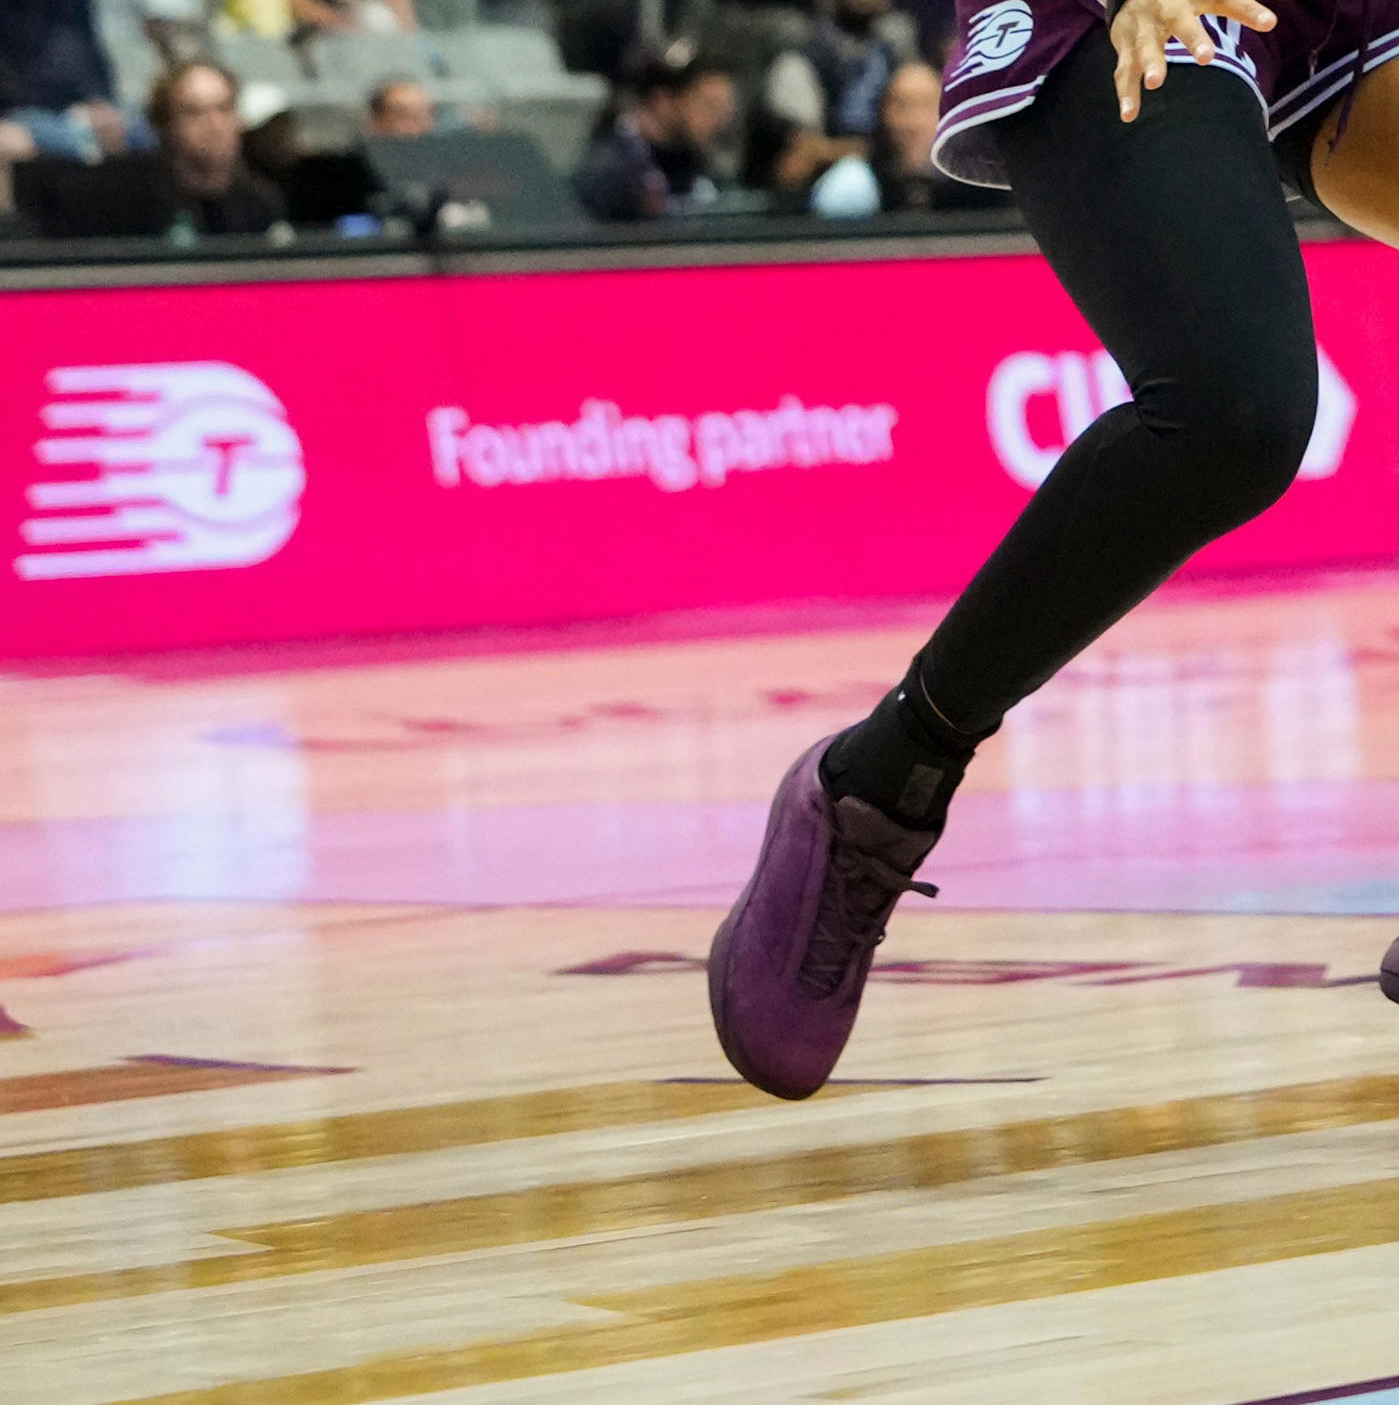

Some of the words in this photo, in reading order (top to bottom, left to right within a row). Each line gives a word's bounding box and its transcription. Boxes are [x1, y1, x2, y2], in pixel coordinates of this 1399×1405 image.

[425, 397, 698, 493] Founding
[696, 394, 900, 488] partner
[986, 350, 1134, 492] CI
